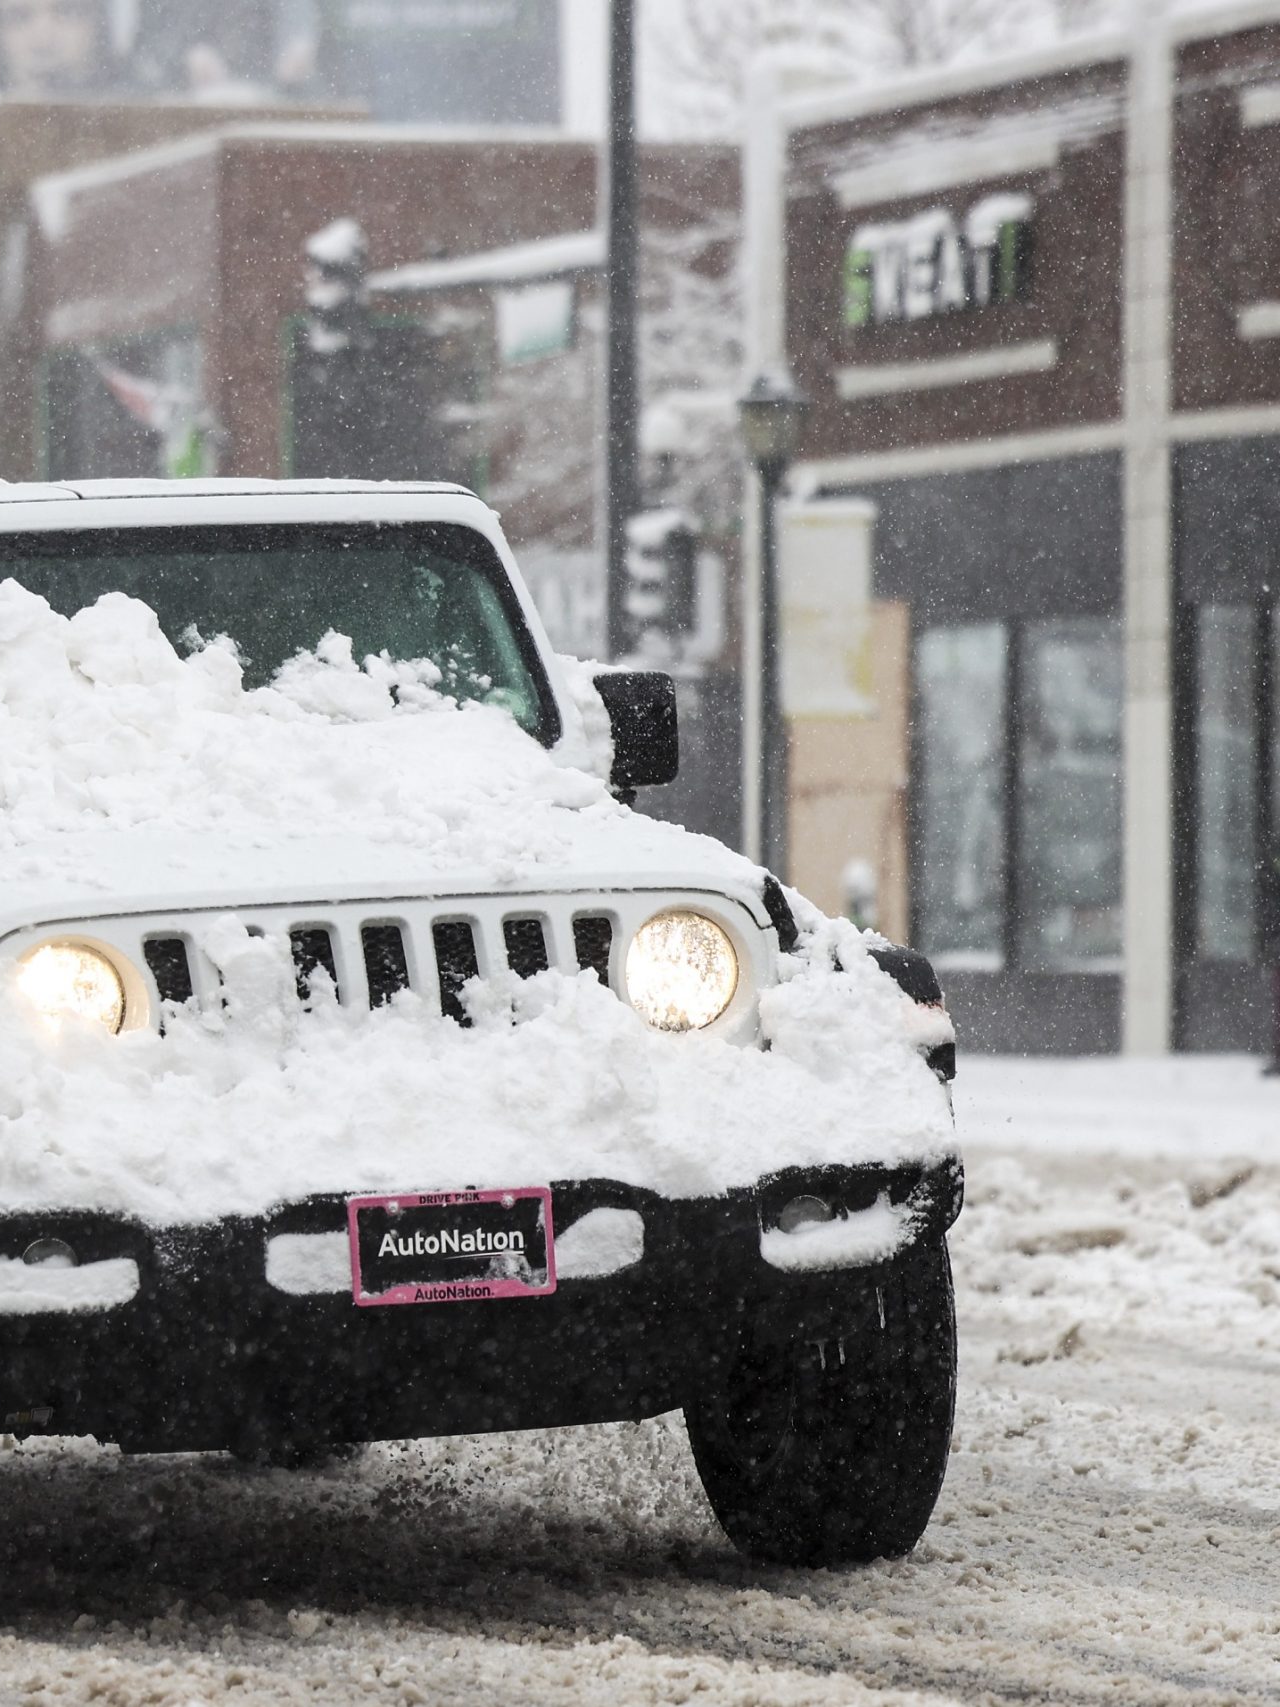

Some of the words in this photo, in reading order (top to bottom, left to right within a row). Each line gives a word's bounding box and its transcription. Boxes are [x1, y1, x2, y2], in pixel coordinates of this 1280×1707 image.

[419, 1194, 451, 1205] DRIVE
[378, 1228, 524, 1257] AutoNation
[415, 1285, 491, 1301] AutoNation
